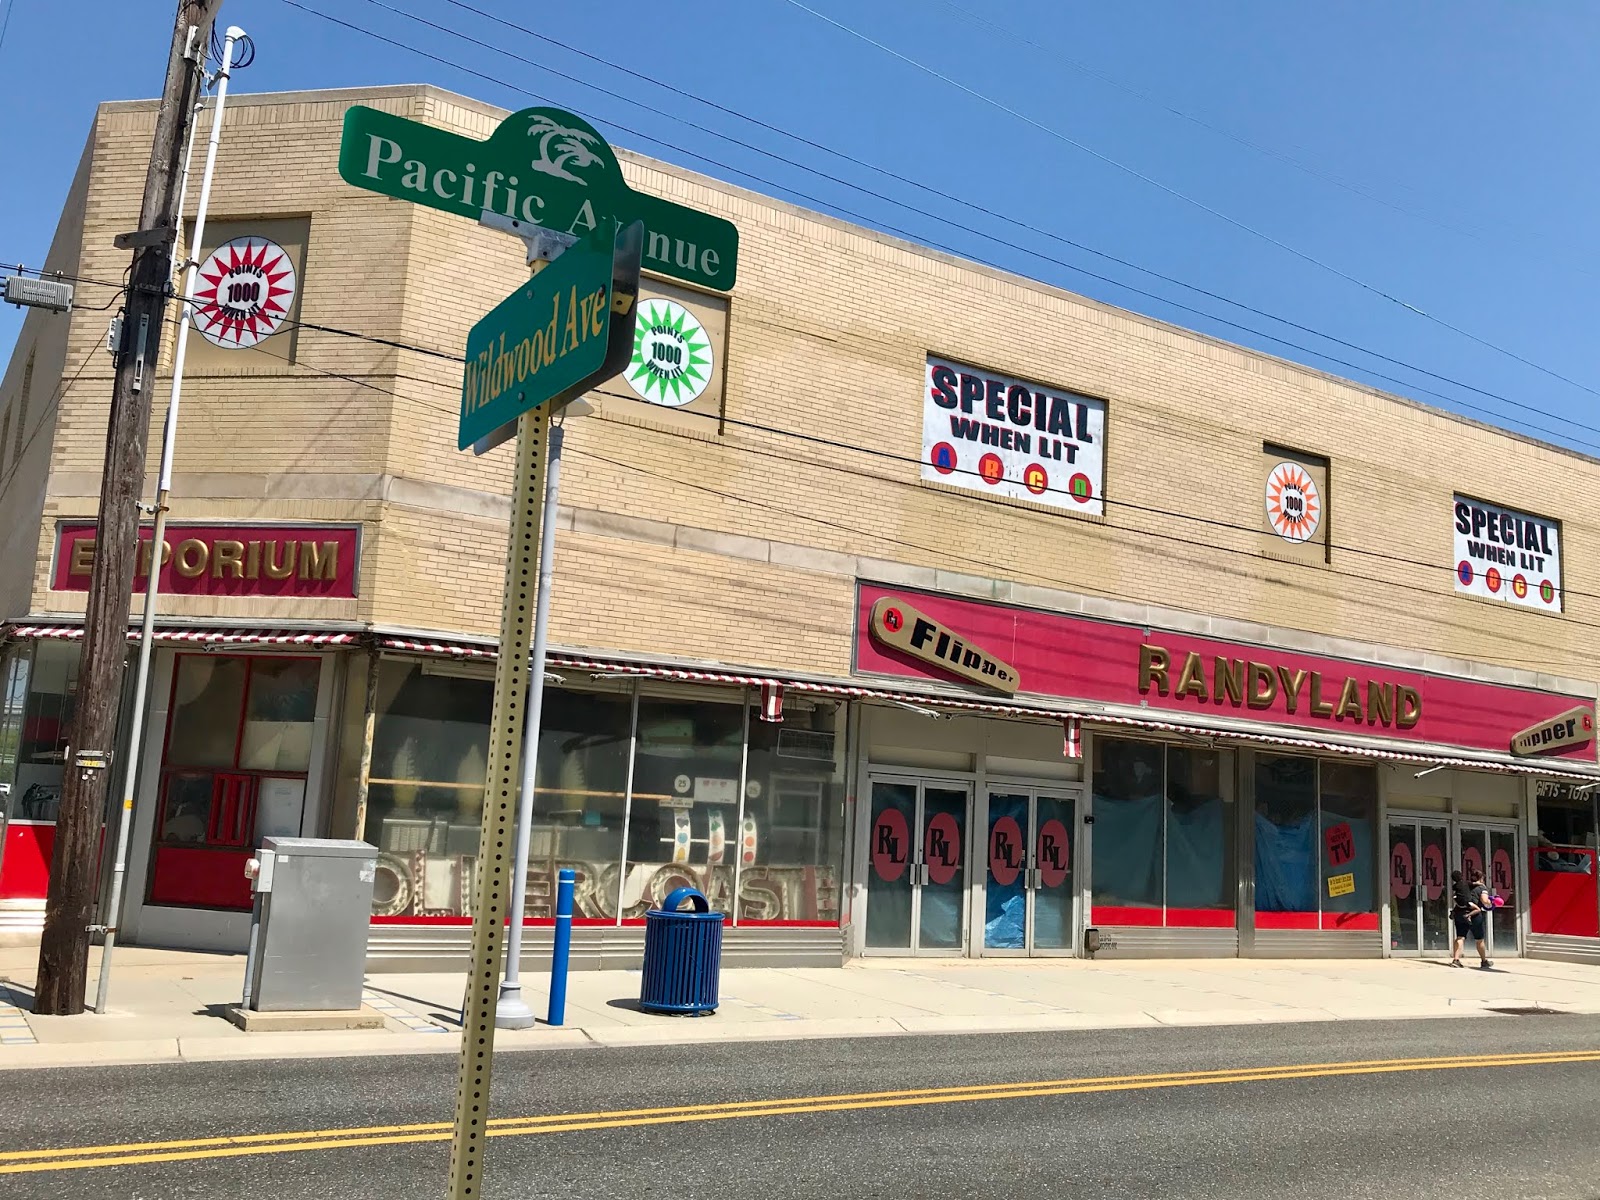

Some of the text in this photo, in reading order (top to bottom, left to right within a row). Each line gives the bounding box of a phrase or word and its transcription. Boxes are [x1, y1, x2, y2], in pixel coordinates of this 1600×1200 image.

[360, 133, 720, 277] Pacific Anue
[228, 264, 265, 278] POINTS
[227, 282, 260, 302] 1000
[650, 325, 685, 343] POINTS
[465, 284, 606, 418] Wildwood Ave
[651, 341, 682, 365] 1000
[646, 359, 684, 380] WHEN LIT
[931, 365, 1093, 443] SPECIAL
[950, 415, 1079, 464] WHEN LIT
[1029, 470, 1044, 491] C
[1285, 495, 1303, 512] 1000
[1455, 502, 1553, 556] SPECIAL
[69, 537, 339, 581] EPORIUM
[1467, 539, 1545, 573] WHEN LIT
[910, 617, 1014, 683] Flipper
[1138, 643, 1422, 729] RANDYLAND
[678, 779, 687, 788] 25
[1536, 781, 1560, 798] GIFTS
[877, 824, 907, 864] RL
[930, 828, 956, 867] RL
[994, 831, 1022, 869] RL
[1041, 834, 1066, 871] RL
[1331, 839, 1351, 863] TV
[1394, 855, 1411, 885] RL
[1425, 857, 1441, 887] RL
[1494, 861, 1510, 889] RL
